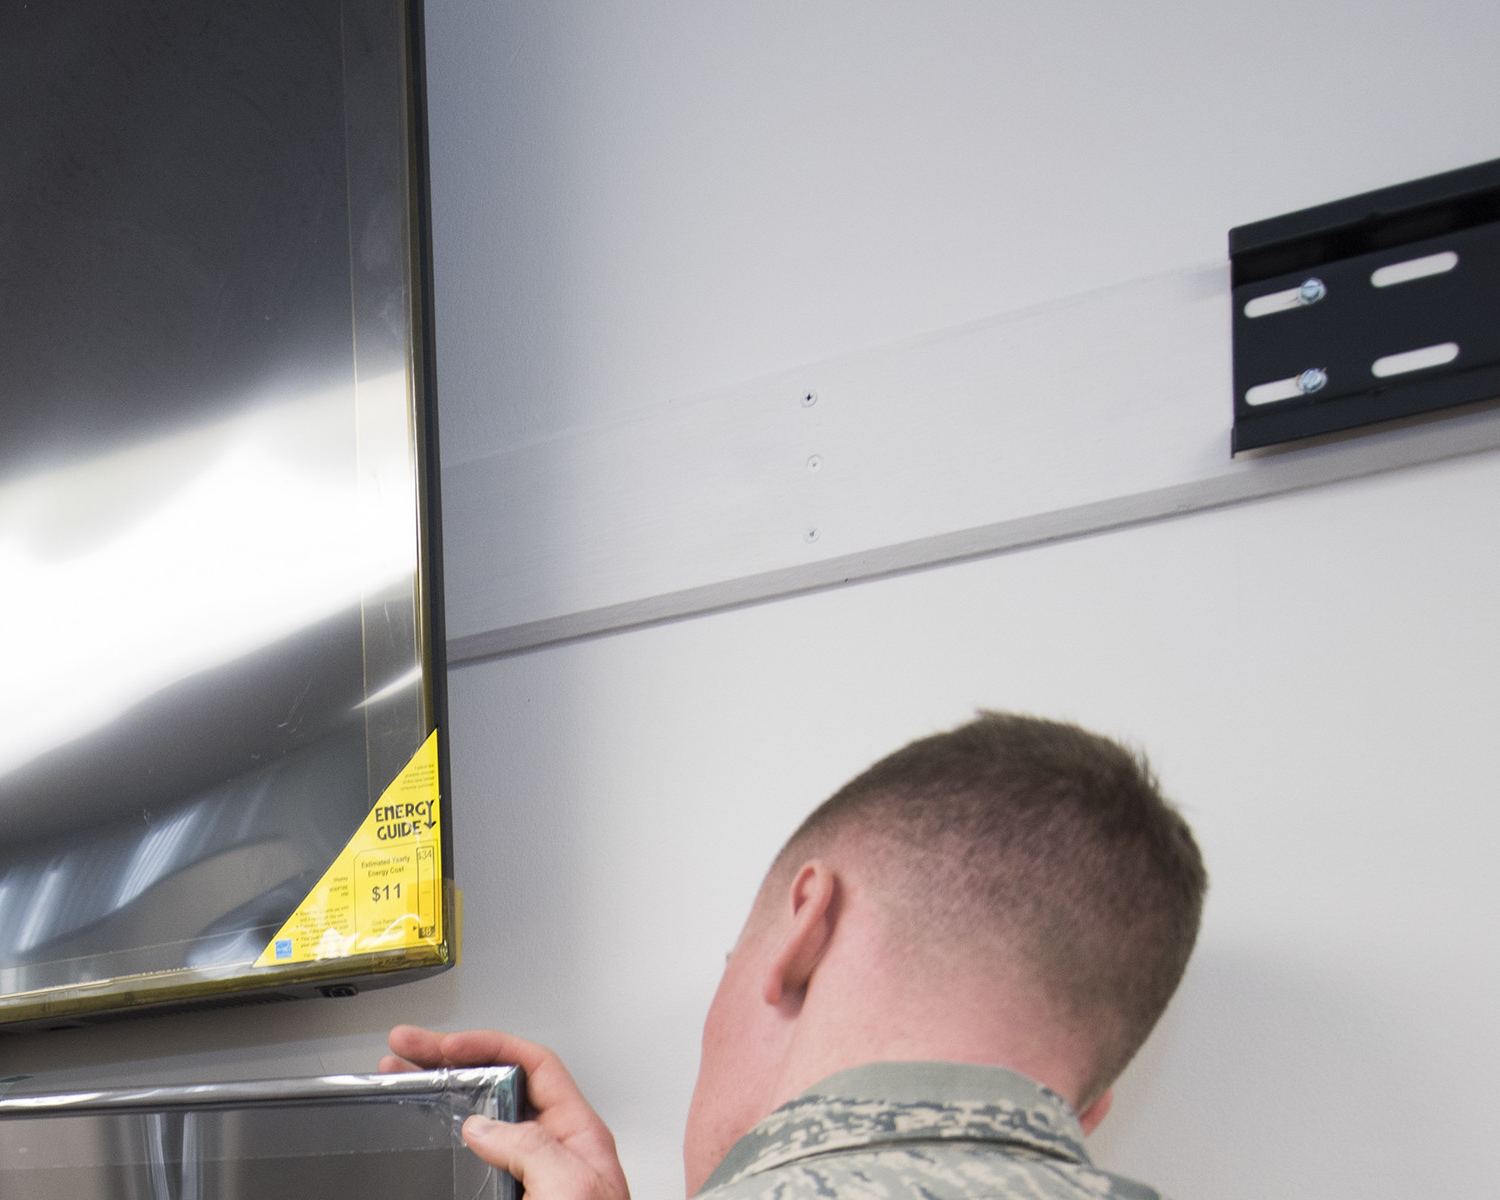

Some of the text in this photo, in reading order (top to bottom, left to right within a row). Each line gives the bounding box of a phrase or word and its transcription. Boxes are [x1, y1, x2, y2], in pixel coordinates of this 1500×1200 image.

[375, 799, 435, 823] ENERGY
[376, 820, 422, 841] GUIDE
[361, 855, 410, 869] Estimated Yearly
[367, 865, 404, 878] Energy Cost
[371, 883, 401, 903] $11
